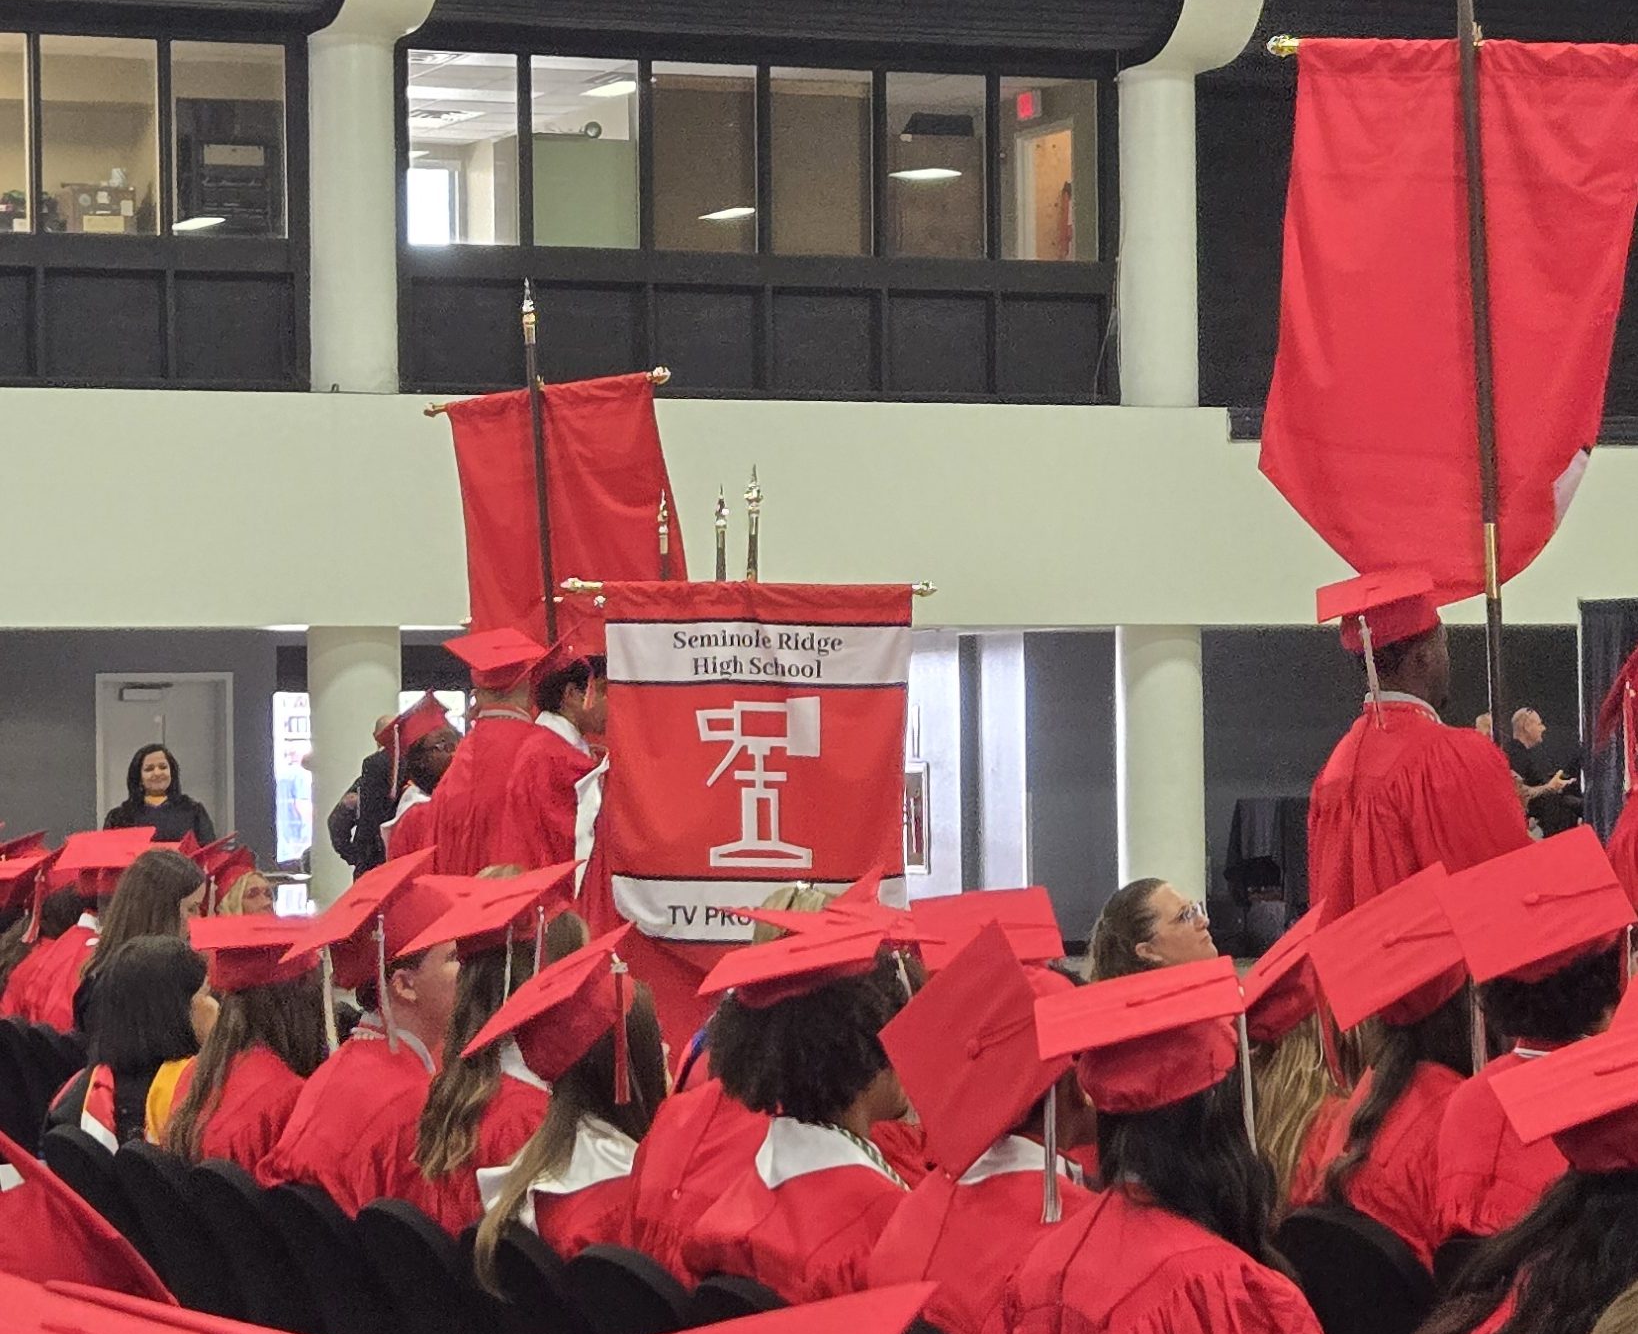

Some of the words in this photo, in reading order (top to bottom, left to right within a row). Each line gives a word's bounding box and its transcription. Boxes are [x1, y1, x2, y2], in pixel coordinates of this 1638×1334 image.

[672, 629, 772, 650] Seminole
[776, 632, 843, 657] Ridge
[693, 655, 743, 677] High
[749, 656, 822, 679] School
[667, 905, 698, 925] TV
